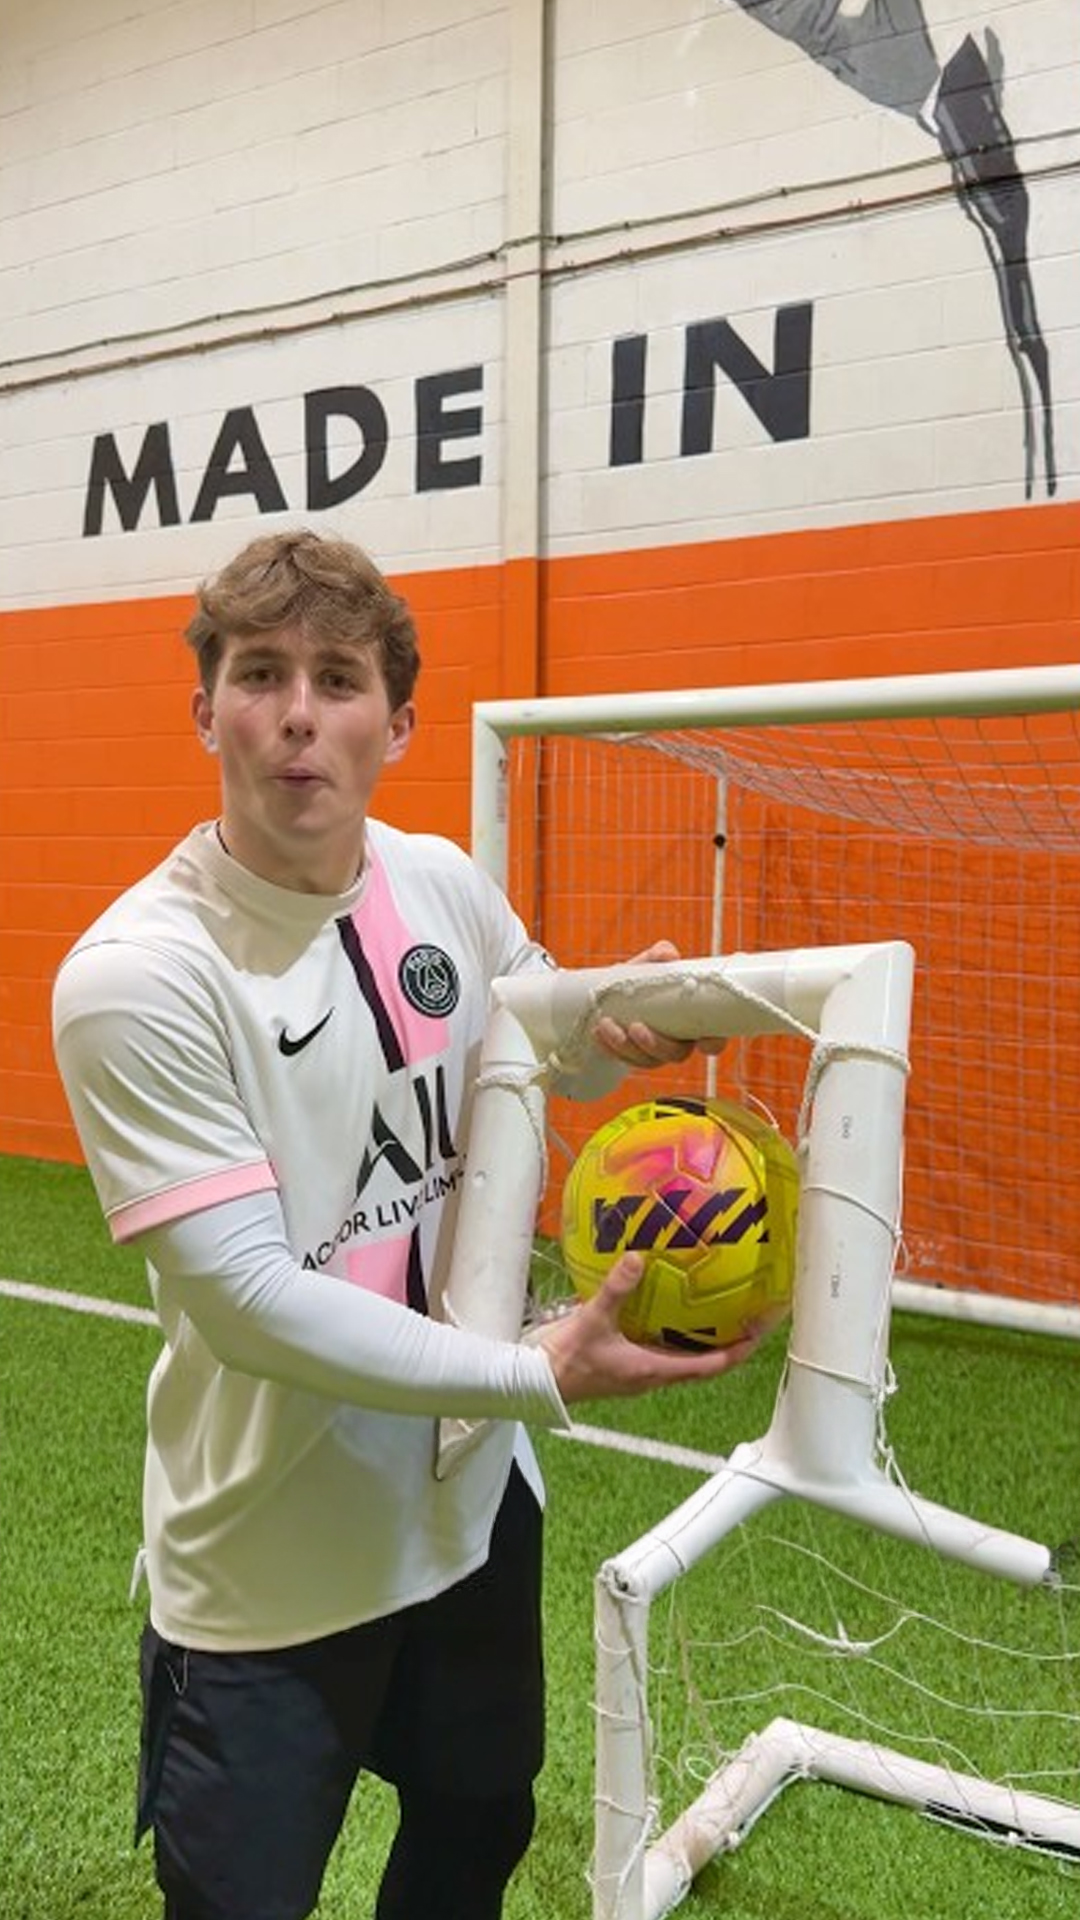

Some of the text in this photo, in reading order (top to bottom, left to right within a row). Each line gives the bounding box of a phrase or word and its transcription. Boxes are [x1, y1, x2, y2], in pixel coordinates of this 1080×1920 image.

[83, 302, 813, 536] MADE IN
[302, 1211, 371, 1271] ACOR
[375, 1192, 423, 1228] LIV
